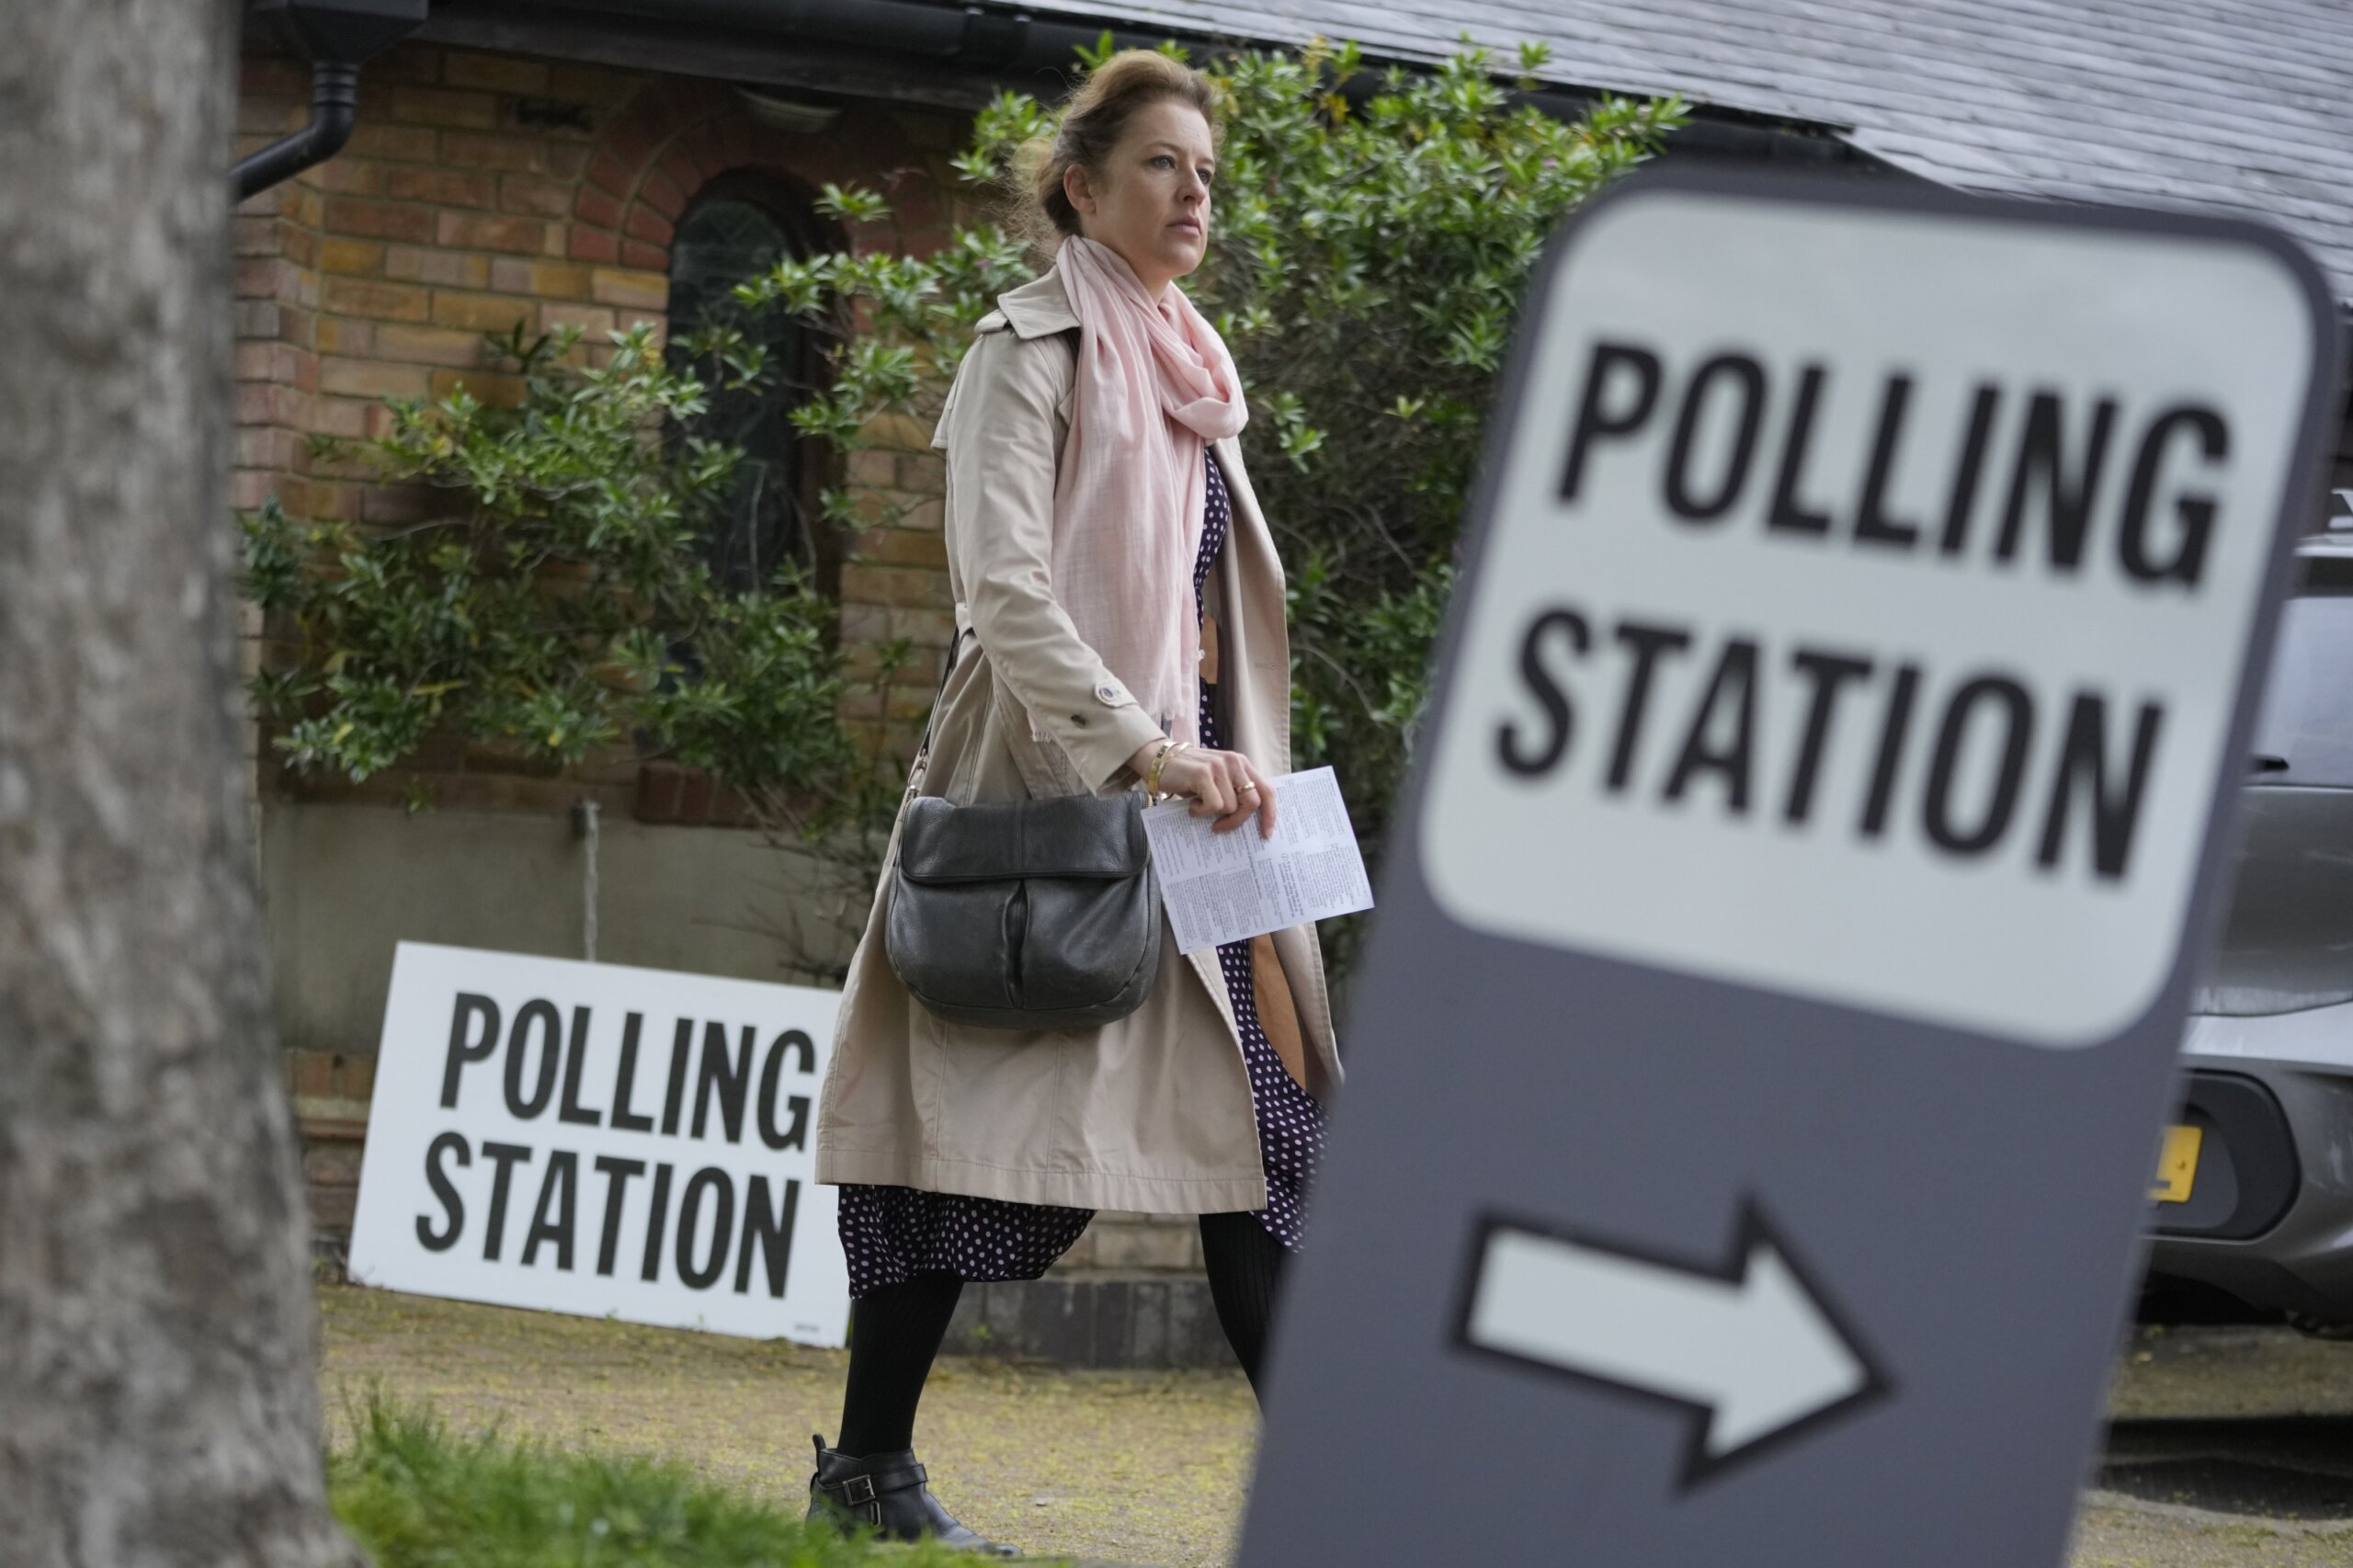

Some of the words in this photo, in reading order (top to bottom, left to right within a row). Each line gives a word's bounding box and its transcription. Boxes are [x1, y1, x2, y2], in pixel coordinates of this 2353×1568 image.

[1553, 334, 2233, 595] POLLING
[1493, 603, 2166, 885] STATION
[439, 991, 816, 1153] POLLING
[415, 1131, 801, 1299] STATION
